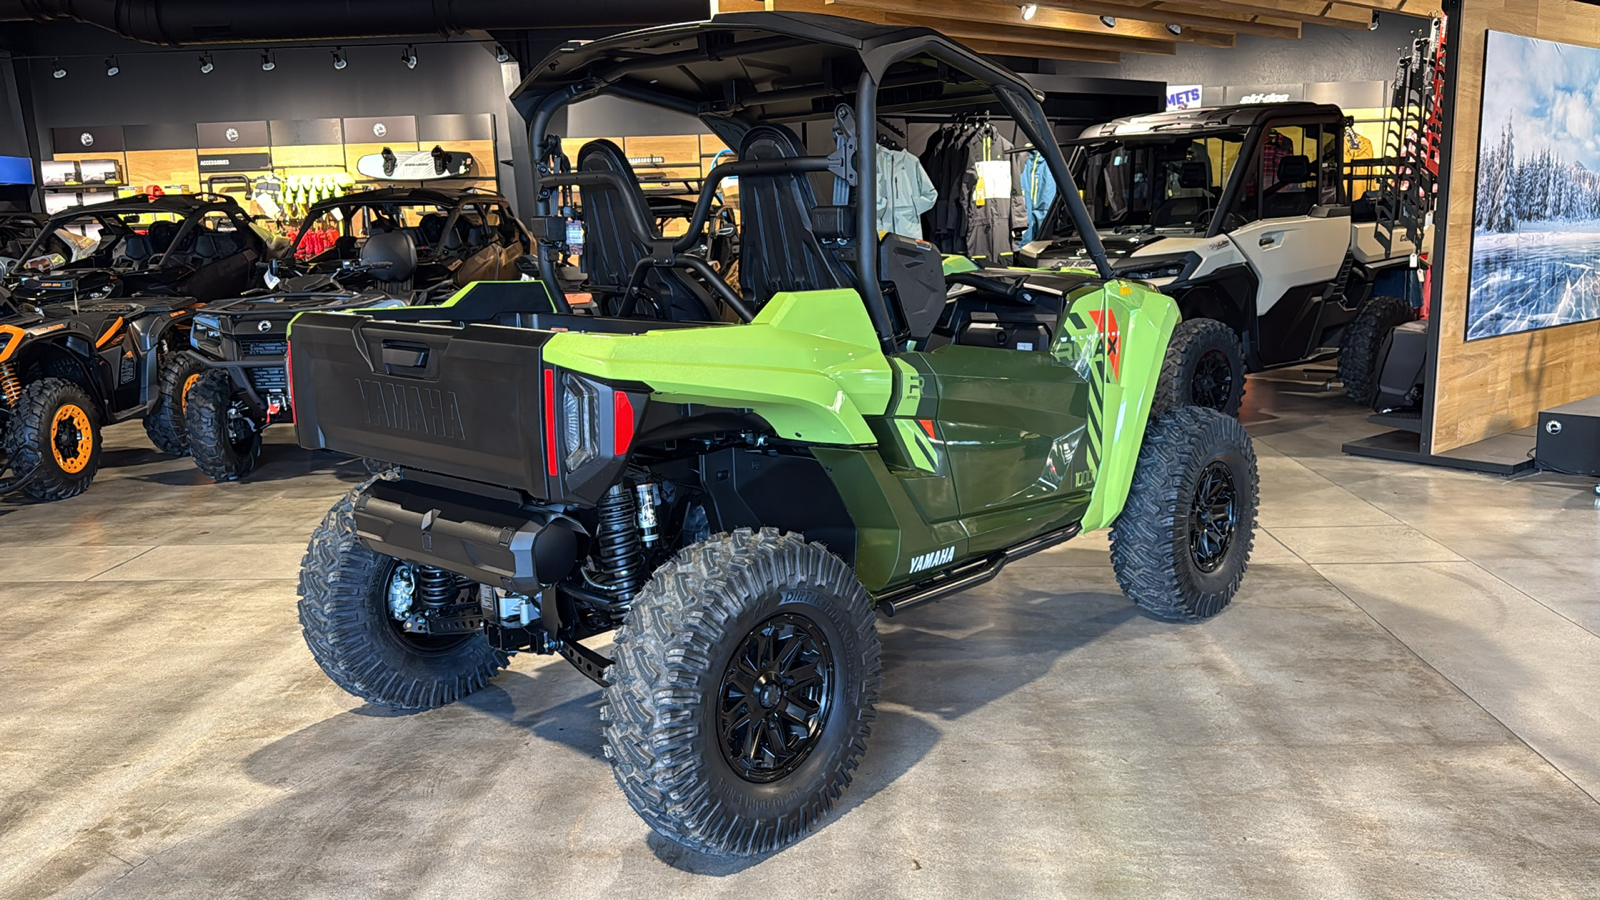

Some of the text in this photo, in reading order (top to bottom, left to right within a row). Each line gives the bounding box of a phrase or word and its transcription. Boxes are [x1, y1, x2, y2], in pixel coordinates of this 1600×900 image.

[355, 378, 466, 441] YAMAHA
[909, 545, 955, 574] YAMAHA
[784, 590, 812, 603] DIRT
